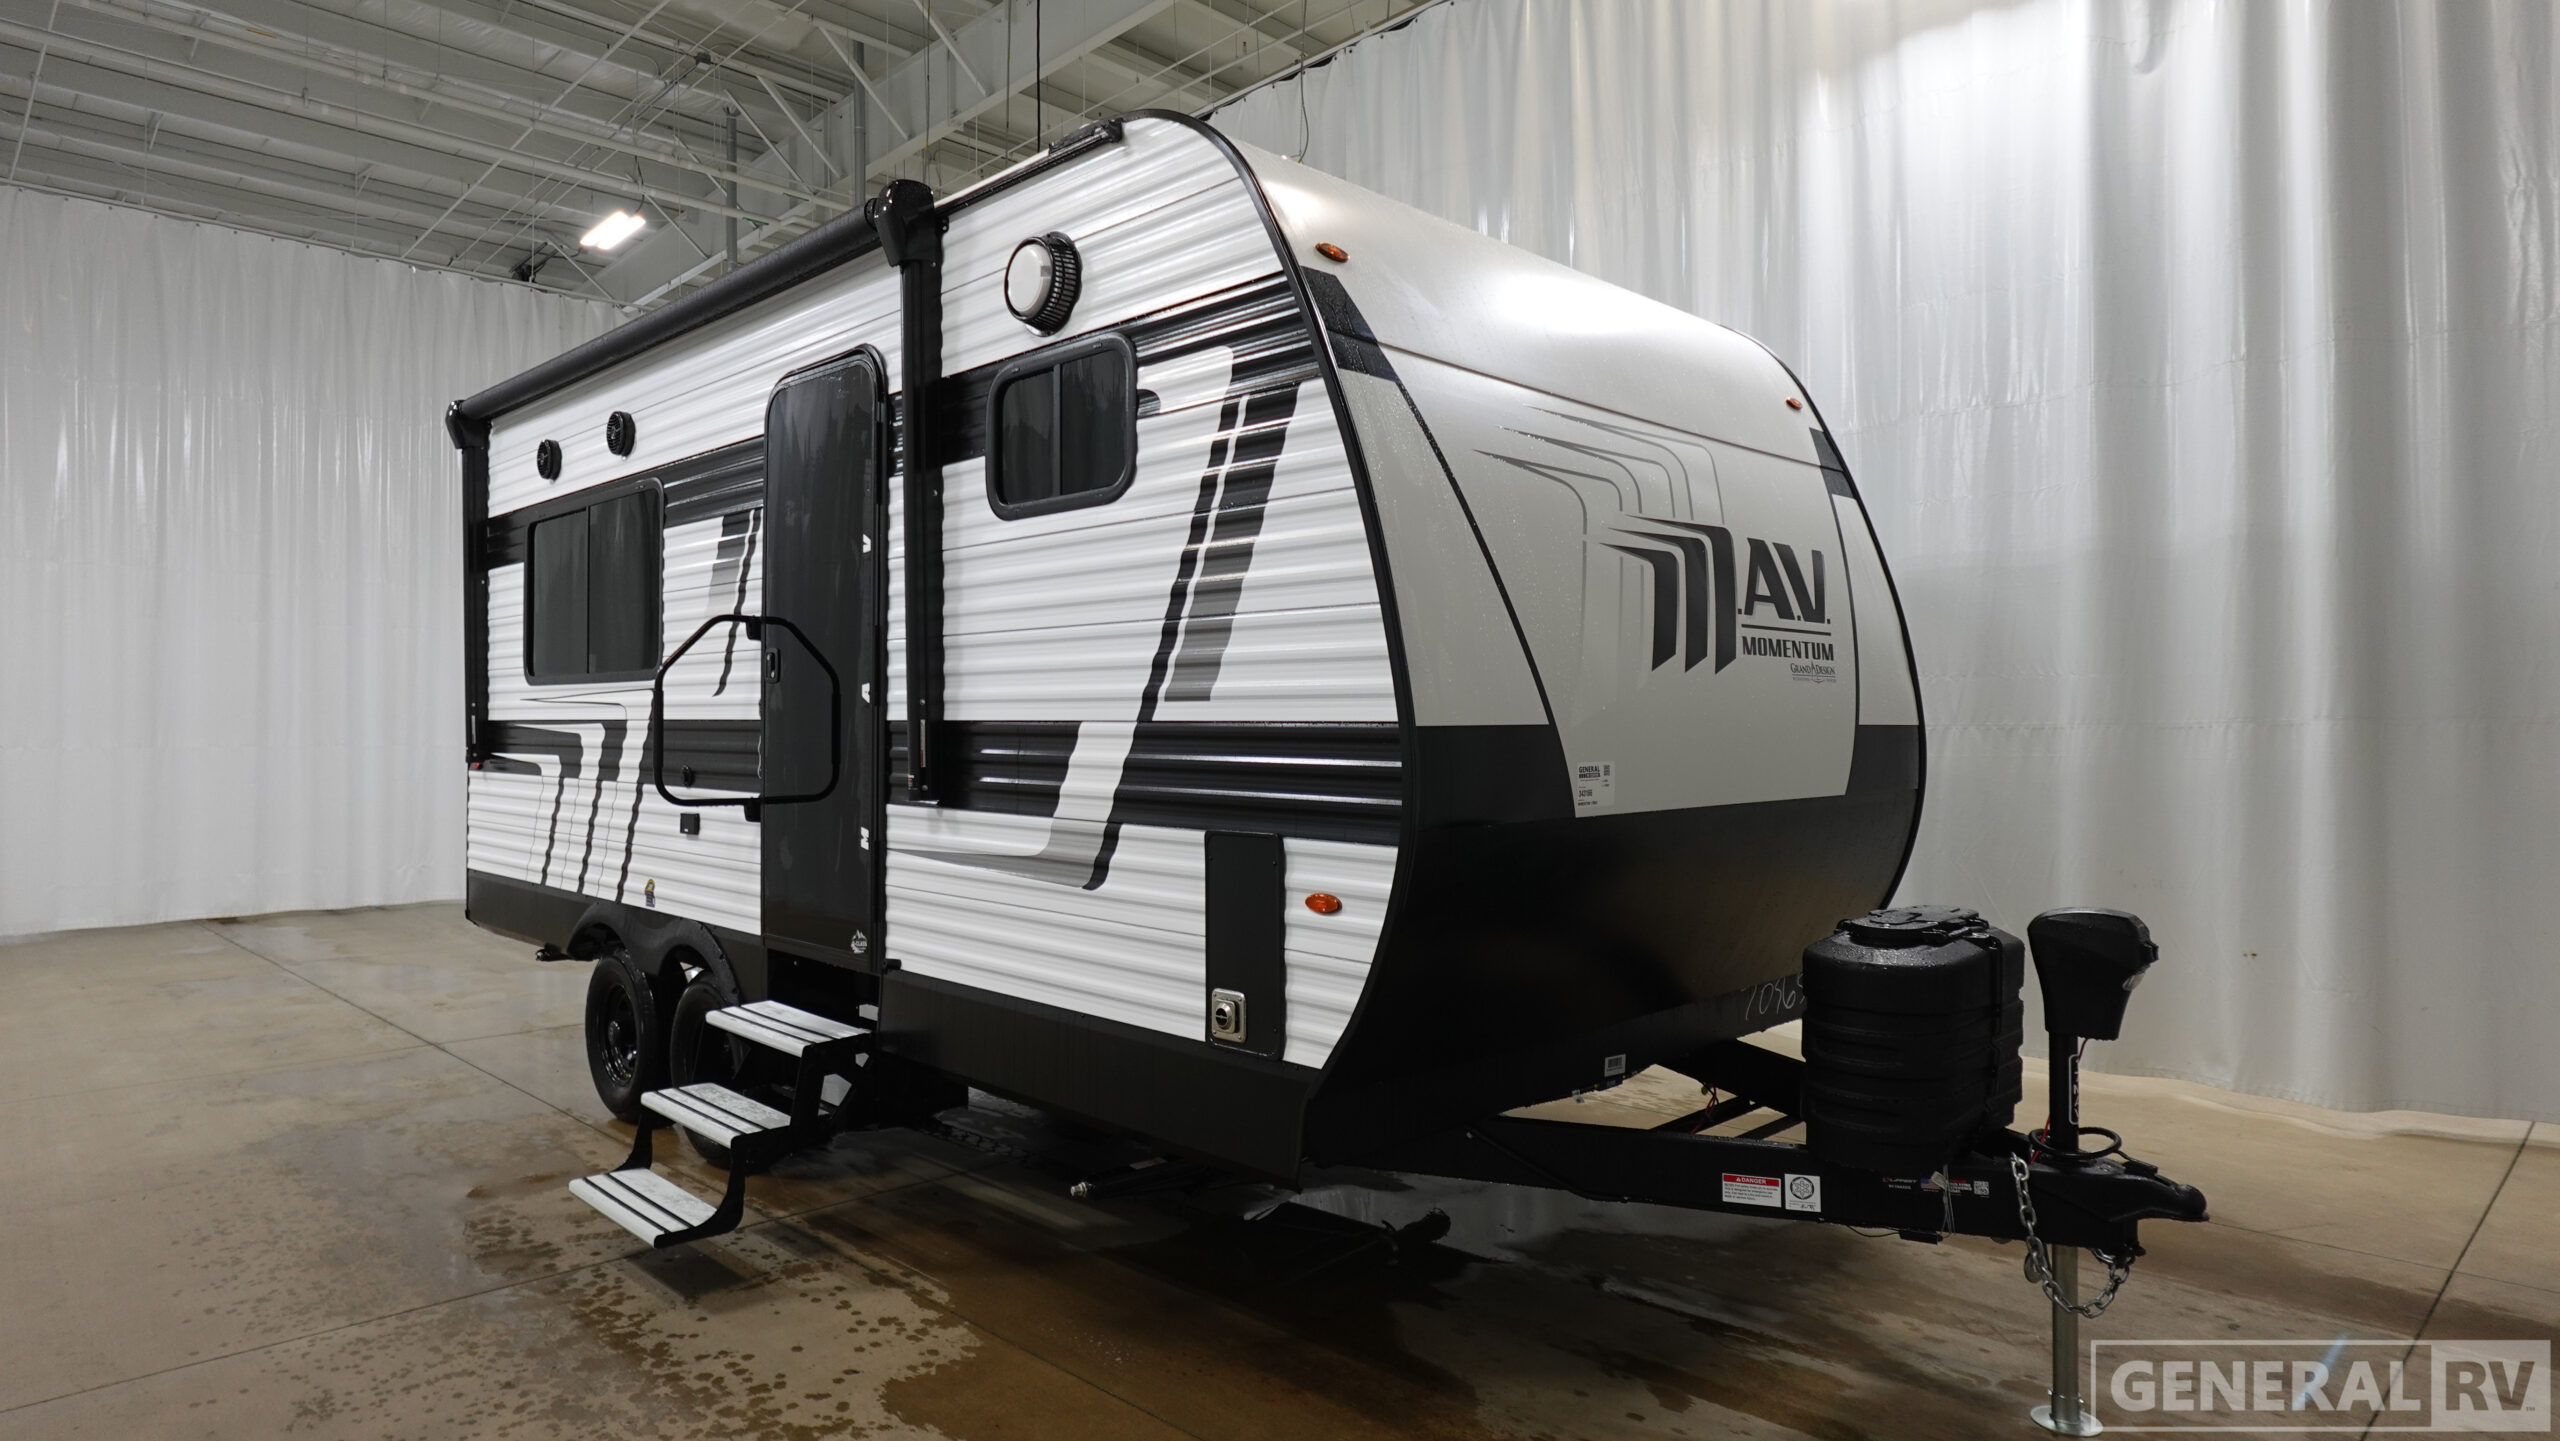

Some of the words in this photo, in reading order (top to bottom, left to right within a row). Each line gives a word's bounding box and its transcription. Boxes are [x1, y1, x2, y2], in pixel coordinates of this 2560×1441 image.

[1742, 636, 1834, 662] MOMENTUM
[1578, 765, 1600, 773] GENERAL
[1741, 1176, 1767, 1185] DANGER
